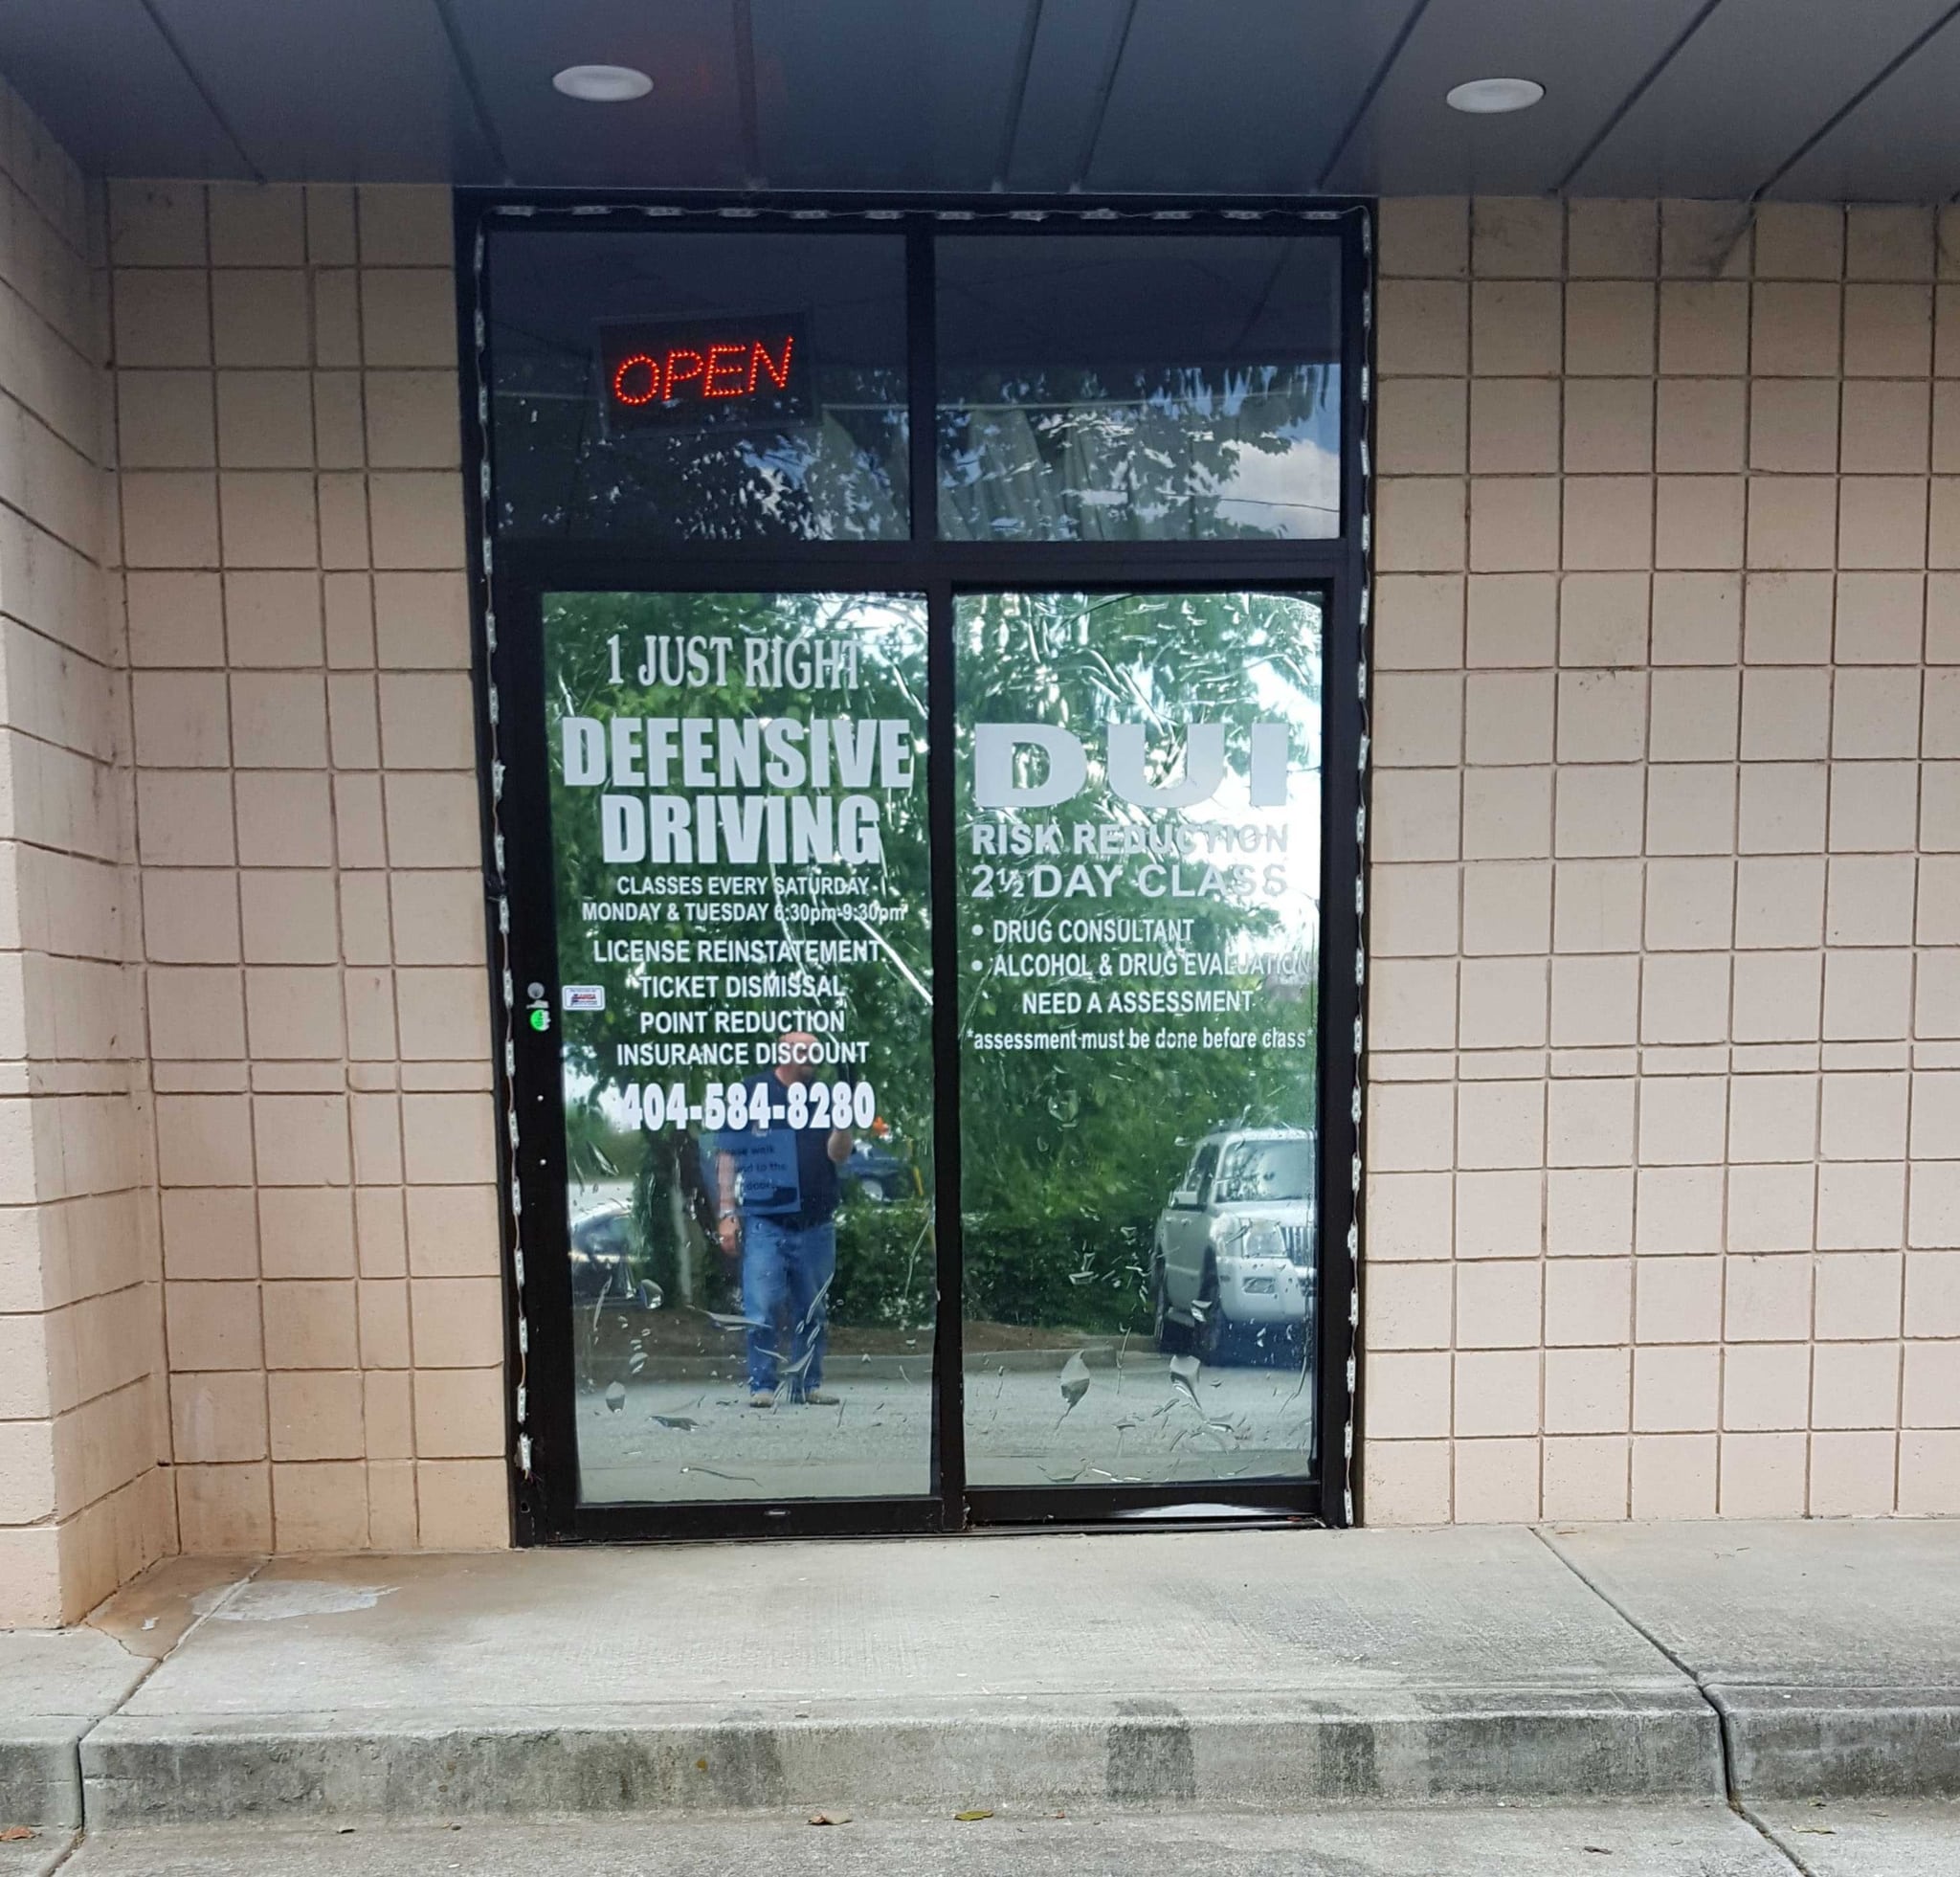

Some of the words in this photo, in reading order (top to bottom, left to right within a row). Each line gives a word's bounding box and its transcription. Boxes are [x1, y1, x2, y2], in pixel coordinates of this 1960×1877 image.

[614, 336, 794, 406] OPEN
[607, 634, 624, 684] 1
[638, 635, 733, 687] JUST
[745, 637, 861, 689] RIGHT
[562, 716, 912, 789] DEFENSIVE
[974, 723, 1289, 808] DUI
[601, 794, 880, 864] DRIVING
[971, 824, 1062, 855] RISK
[1073, 824, 1288, 855] REDUCTION
[616, 877, 702, 895] CLASSES
[708, 877, 768, 895] EVERY
[774, 877, 869, 895] SATURDAY
[1033, 864, 1123, 897] DAY
[1138, 864, 1288, 898] CLASS
[582, 904, 662, 922] MONDAY
[667, 904, 680, 922] &
[684, 903, 769, 921] TUESDAY
[773, 903, 905, 926] 6:30pm-9:30pm
[993, 919, 1054, 944] DRUG
[1058, 918, 1195, 943] CONSULTANT
[593, 940, 691, 963] LICENSE
[697, 939, 881, 962] REINSTATEMENT
[992, 953, 1093, 977] ALCOHOL
[1100, 953, 1114, 976] &
[1119, 953, 1178, 976] DRUG
[1184, 952, 1310, 975] EVALUATION
[638, 976, 720, 998] TICKET
[725, 975, 845, 998] DISMISSAL
[1022, 992, 1082, 1015] NEED
[1086, 992, 1103, 1013] A
[1107, 990, 1255, 1013] ASSESSMENT
[639, 1011, 708, 1034] POINT
[715, 1010, 846, 1034] REDUCTION
[1081, 1028, 1125, 1049] must
[1129, 1027, 1150, 1049] be
[1155, 1027, 1197, 1048] done
[1202, 1027, 1257, 1048] before
[617, 1042, 748, 1065] INSURANCE
[755, 1041, 870, 1064] DISCOUNT
[622, 1082, 876, 1130] 404-584-8280
